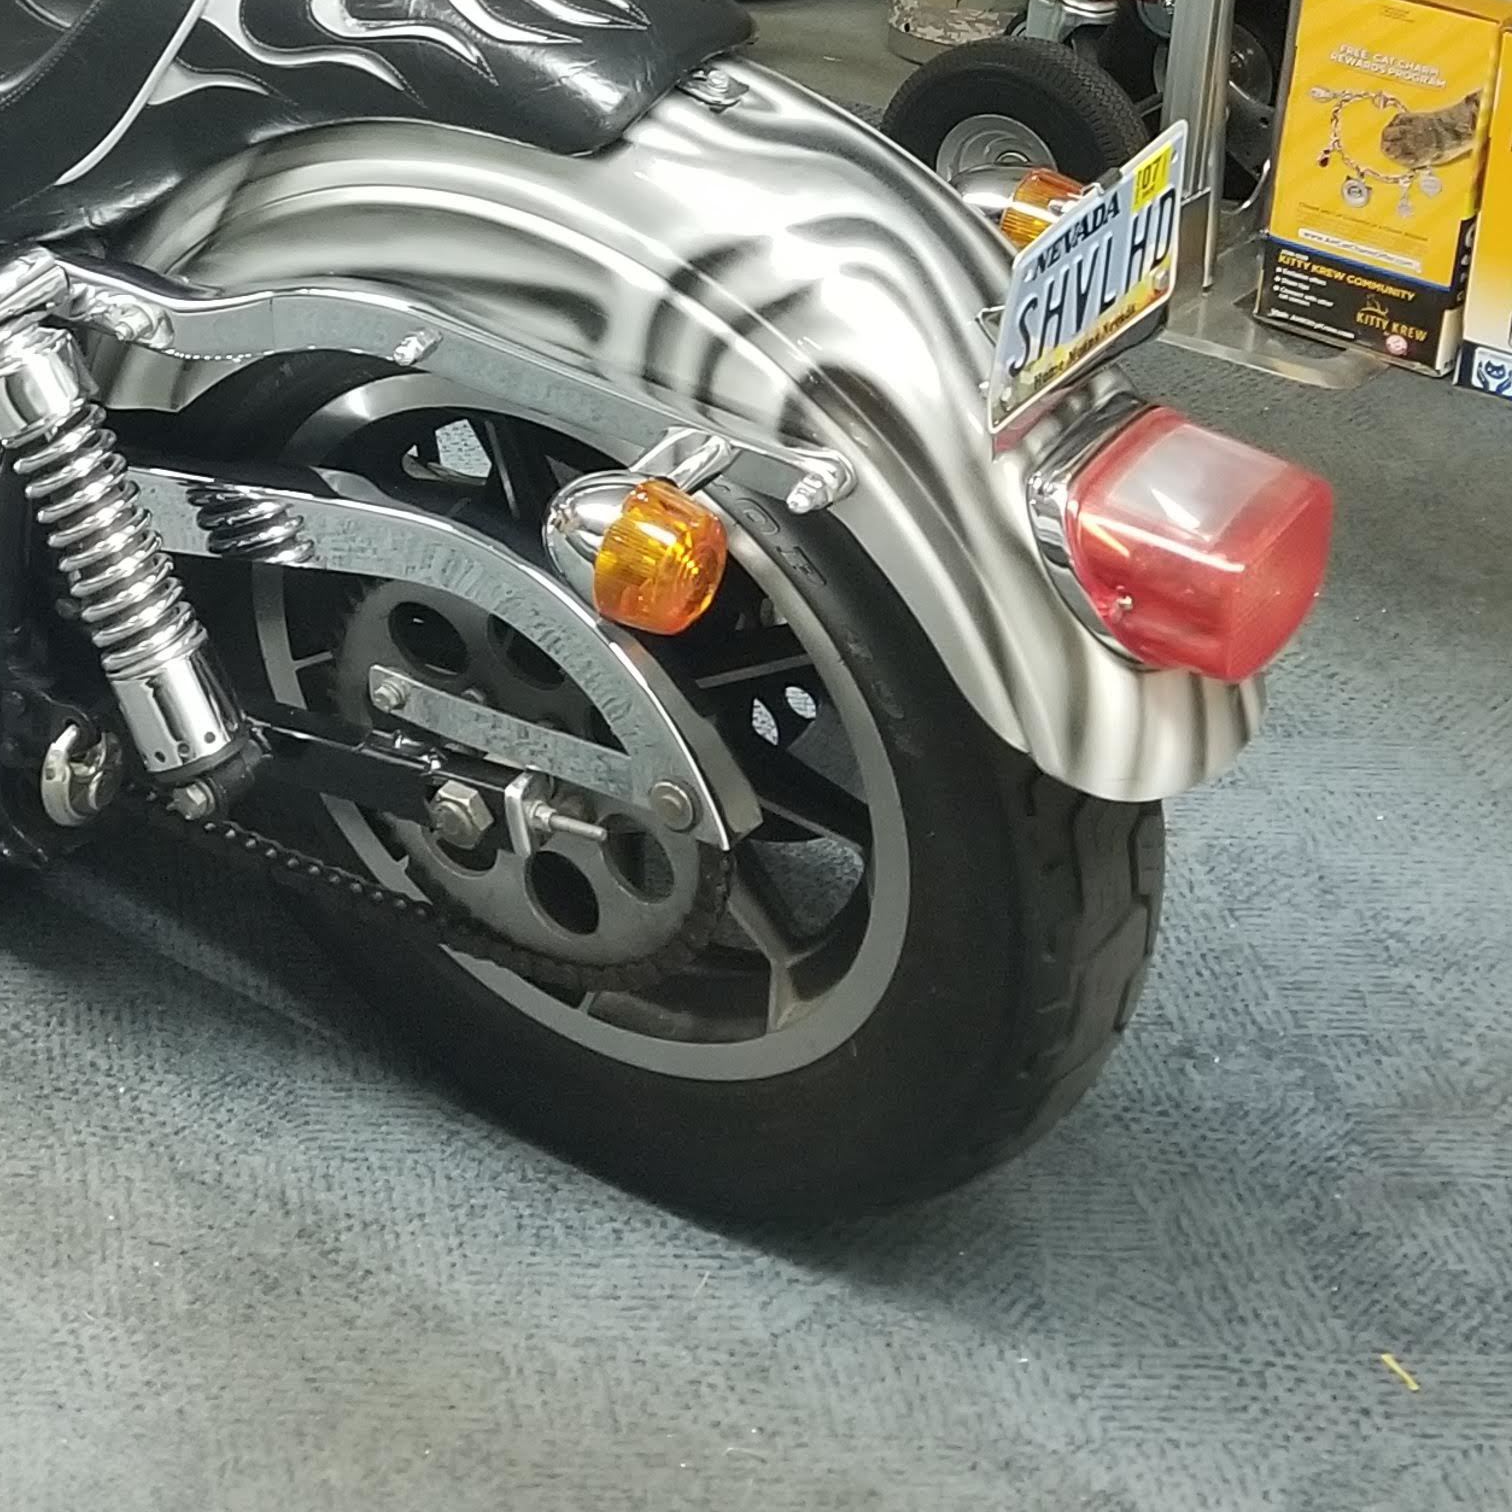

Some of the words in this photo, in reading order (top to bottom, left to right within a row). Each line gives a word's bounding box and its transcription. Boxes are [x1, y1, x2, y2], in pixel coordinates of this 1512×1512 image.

[1330, 52, 1386, 75] REWARDS
[1388, 68, 1447, 88] PROGRAM
[1033, 192, 1121, 277] NEVADA
[1009, 234, 1117, 378] SHVL
[1126, 188, 1177, 296] HD
[1278, 253, 1311, 271] KITTY
[1311, 262, 1345, 281] KREW
[1346, 275, 1416, 302] COMMUNITY
[1356, 311, 1390, 330] KITTY
[1391, 322, 1427, 341] KREW
